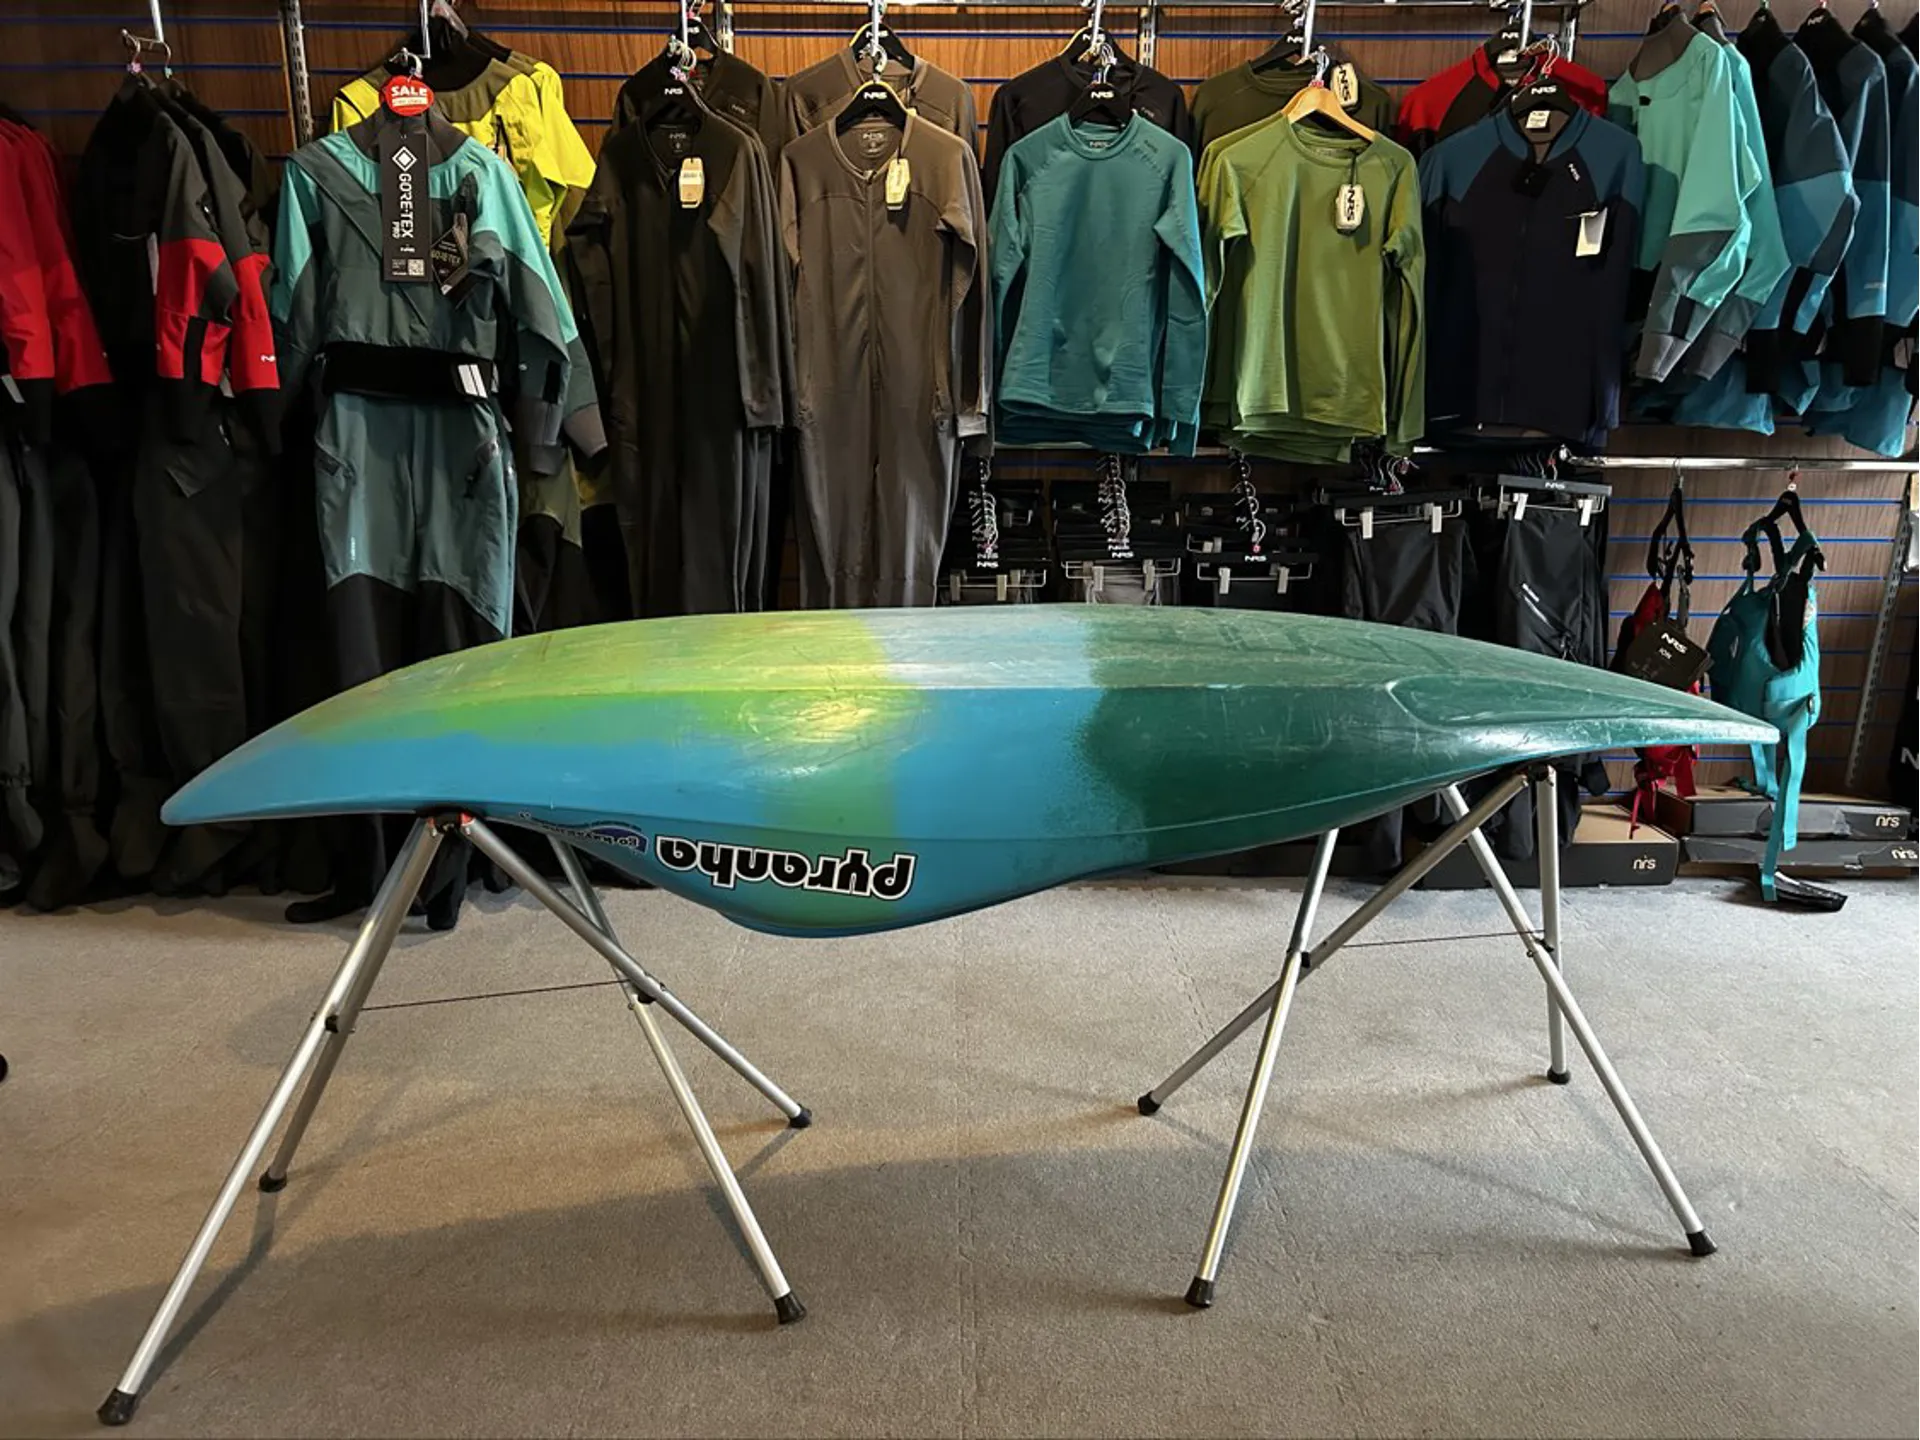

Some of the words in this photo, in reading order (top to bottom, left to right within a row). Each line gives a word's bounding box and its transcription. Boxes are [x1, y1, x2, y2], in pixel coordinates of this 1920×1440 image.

[391, 85, 428, 98] SALE
[1338, 68, 1352, 102] NRS
[1531, 85, 1557, 95] NRS
[664, 88, 684, 96] NRS
[863, 91, 888, 100] NRS
[1090, 90, 1115, 99] NRS
[398, 173, 415, 239] GORE-TEX
[1347, 189, 1356, 222] NRS
[391, 221, 401, 240] PRO
[1545, 481, 1566, 490] NRS
[1111, 550, 1135, 559] NRS
[1244, 554, 1267, 563] NRS
[976, 560, 1000, 569] NRS
[1660, 632, 1688, 654] NRS
[1875, 813, 1900, 829] nrs
[655, 834, 917, 901] pyranha
[1633, 856, 1656, 870] nrs
